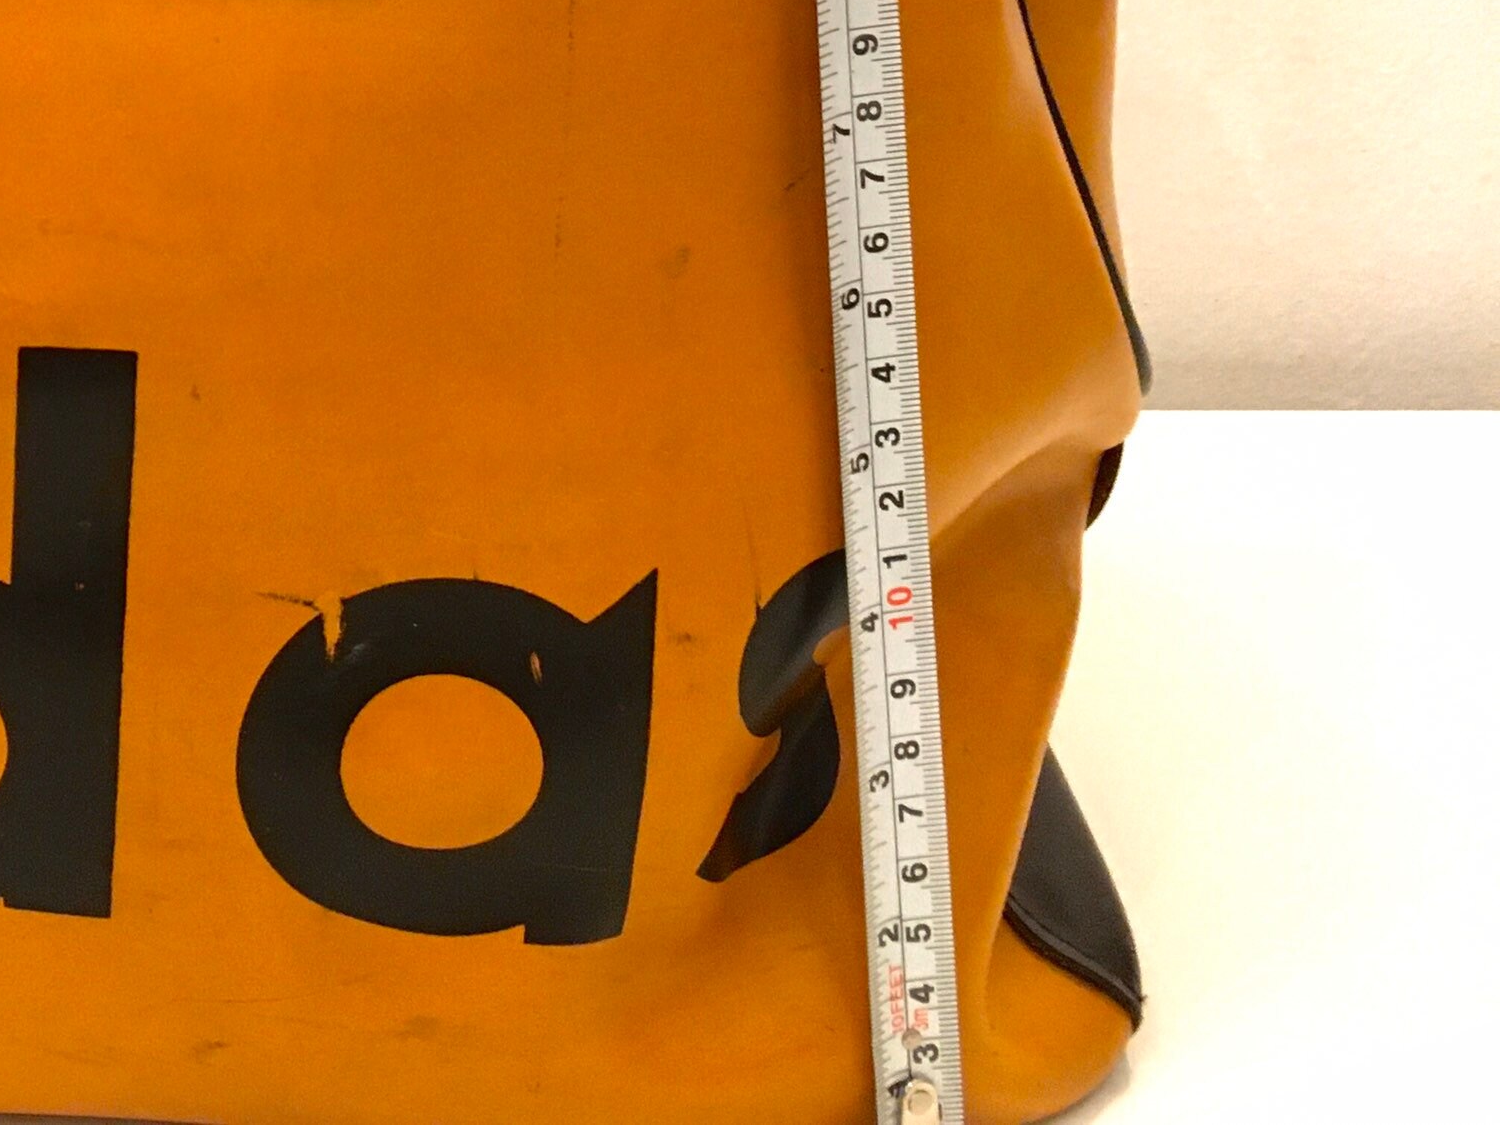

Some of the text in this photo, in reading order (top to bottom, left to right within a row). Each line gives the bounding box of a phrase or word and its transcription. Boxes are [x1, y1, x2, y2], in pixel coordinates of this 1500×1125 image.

[853, 34, 878, 56] 9
[856, 101, 882, 121] 8
[832, 124, 850, 143] 7
[860, 169, 885, 189] 7
[864, 232, 889, 253] 6
[842, 288, 860, 310] 6
[867, 298, 892, 318] 5
[872, 363, 895, 383] 4
[875, 427, 900, 448] 3
[851, 452, 869, 475] 5
[879, 490, 904, 511] 2
[883, 554, 907, 569] 1
[887, 586, 913, 629] 10
[861, 612, 879, 632] 4
[890, 679, 916, 699] 9
[894, 740, 920, 760] 8
[869, 770, 889, 793] 3
[898, 804, 923, 823] 7
[902, 862, 928, 883] 6
[878, 923, 899, 947] 2
[906, 924, 931, 943] 5
[909, 983, 934, 1003] 4
[913, 1044, 939, 1064] 3
